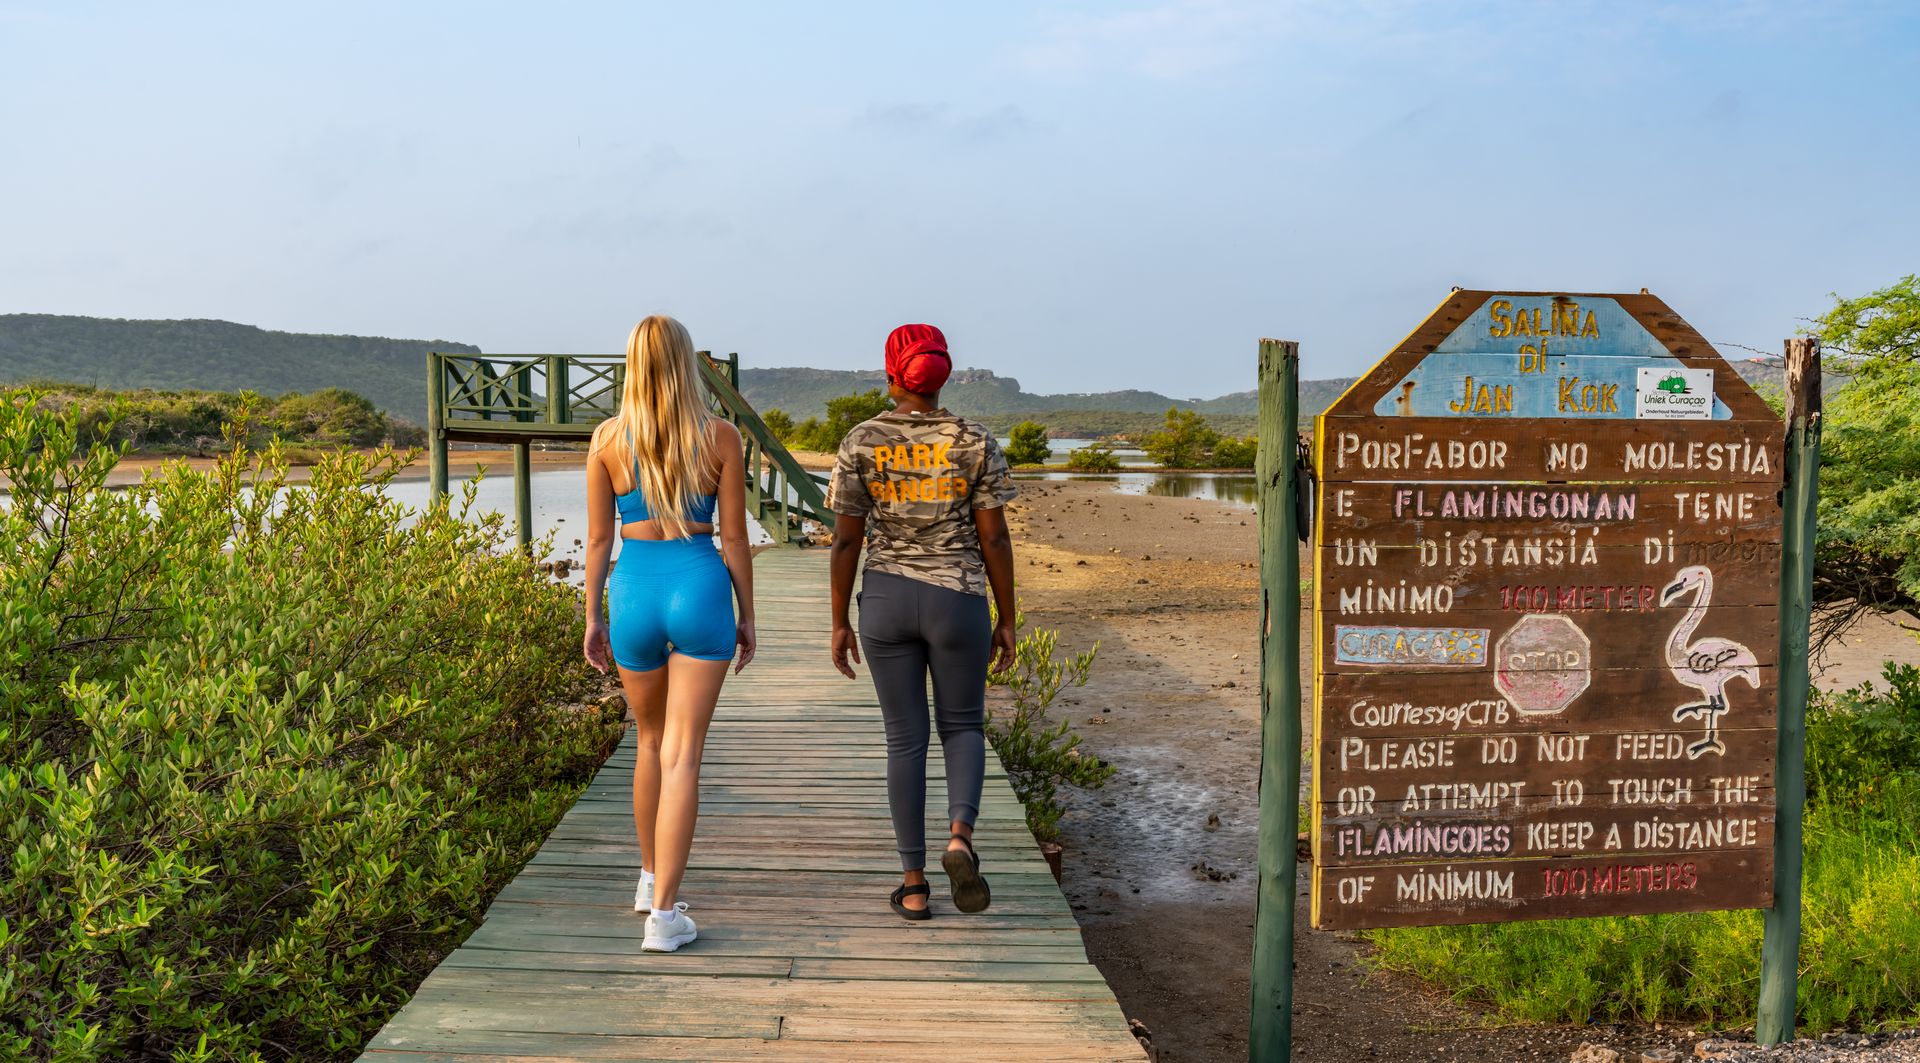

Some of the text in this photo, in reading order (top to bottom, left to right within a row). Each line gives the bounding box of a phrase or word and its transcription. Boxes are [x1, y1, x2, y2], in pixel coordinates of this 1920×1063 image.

[1450, 376, 1619, 414] JAN KOK
[1644, 394, 1706, 406] Uniek Curaçao
[874, 442, 952, 471] PARK
[1548, 442, 1588, 472] NO
[868, 477, 968, 504] RANGER
[1337, 485, 1754, 520] E FLAMINGONAN TENE
[1335, 537, 1378, 566] UN
[1339, 578, 1656, 615] MINIMO 100 METER
[1509, 650, 1580, 679] STOP
[1466, 699, 1510, 725] CTB
[1341, 734, 1684, 772] PLEASE DO NOT FEED
[1337, 776, 1760, 816] OR ATTEMPT TO TOUCH THE
[1338, 816, 1757, 856] FLAMINGOES KEEP A DISTANCE
[1338, 862, 1698, 905] OF MINIMUM 100 METERS
